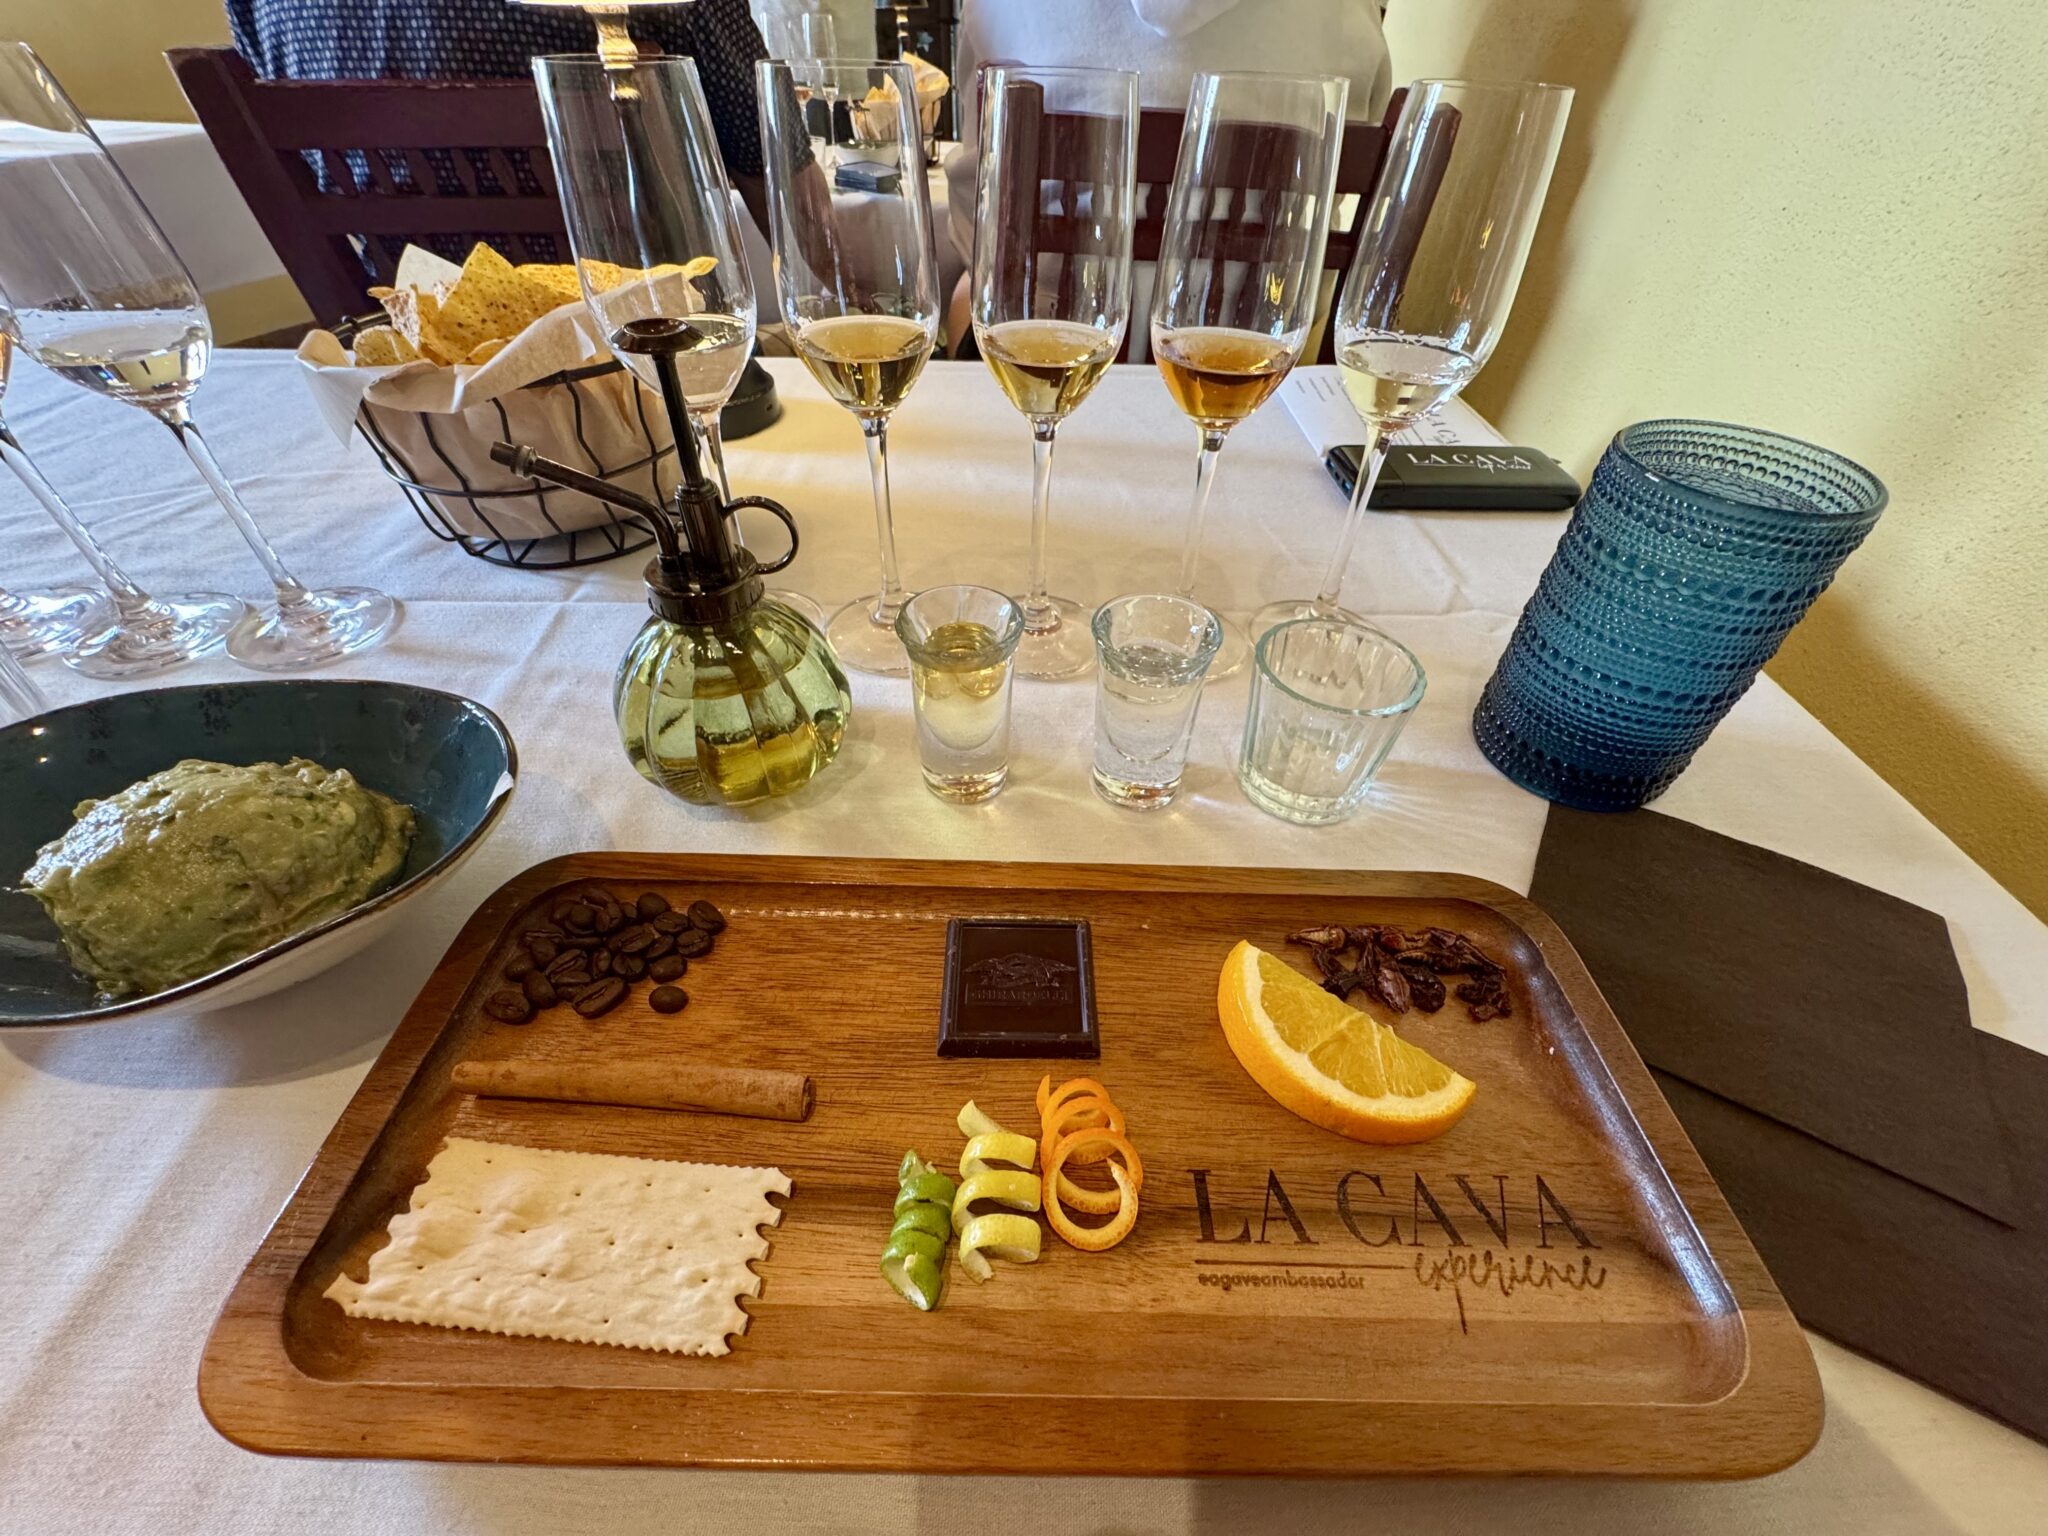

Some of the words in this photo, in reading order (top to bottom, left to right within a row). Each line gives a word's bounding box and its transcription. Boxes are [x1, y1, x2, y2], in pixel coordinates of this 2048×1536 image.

[1406, 452, 1448, 464] LA
[1452, 453, 1532, 466] CAVA
[1187, 1168, 1320, 1245] LA
[1336, 1170, 1602, 1249] CAVA
[1414, 1249, 1607, 1335] experience
